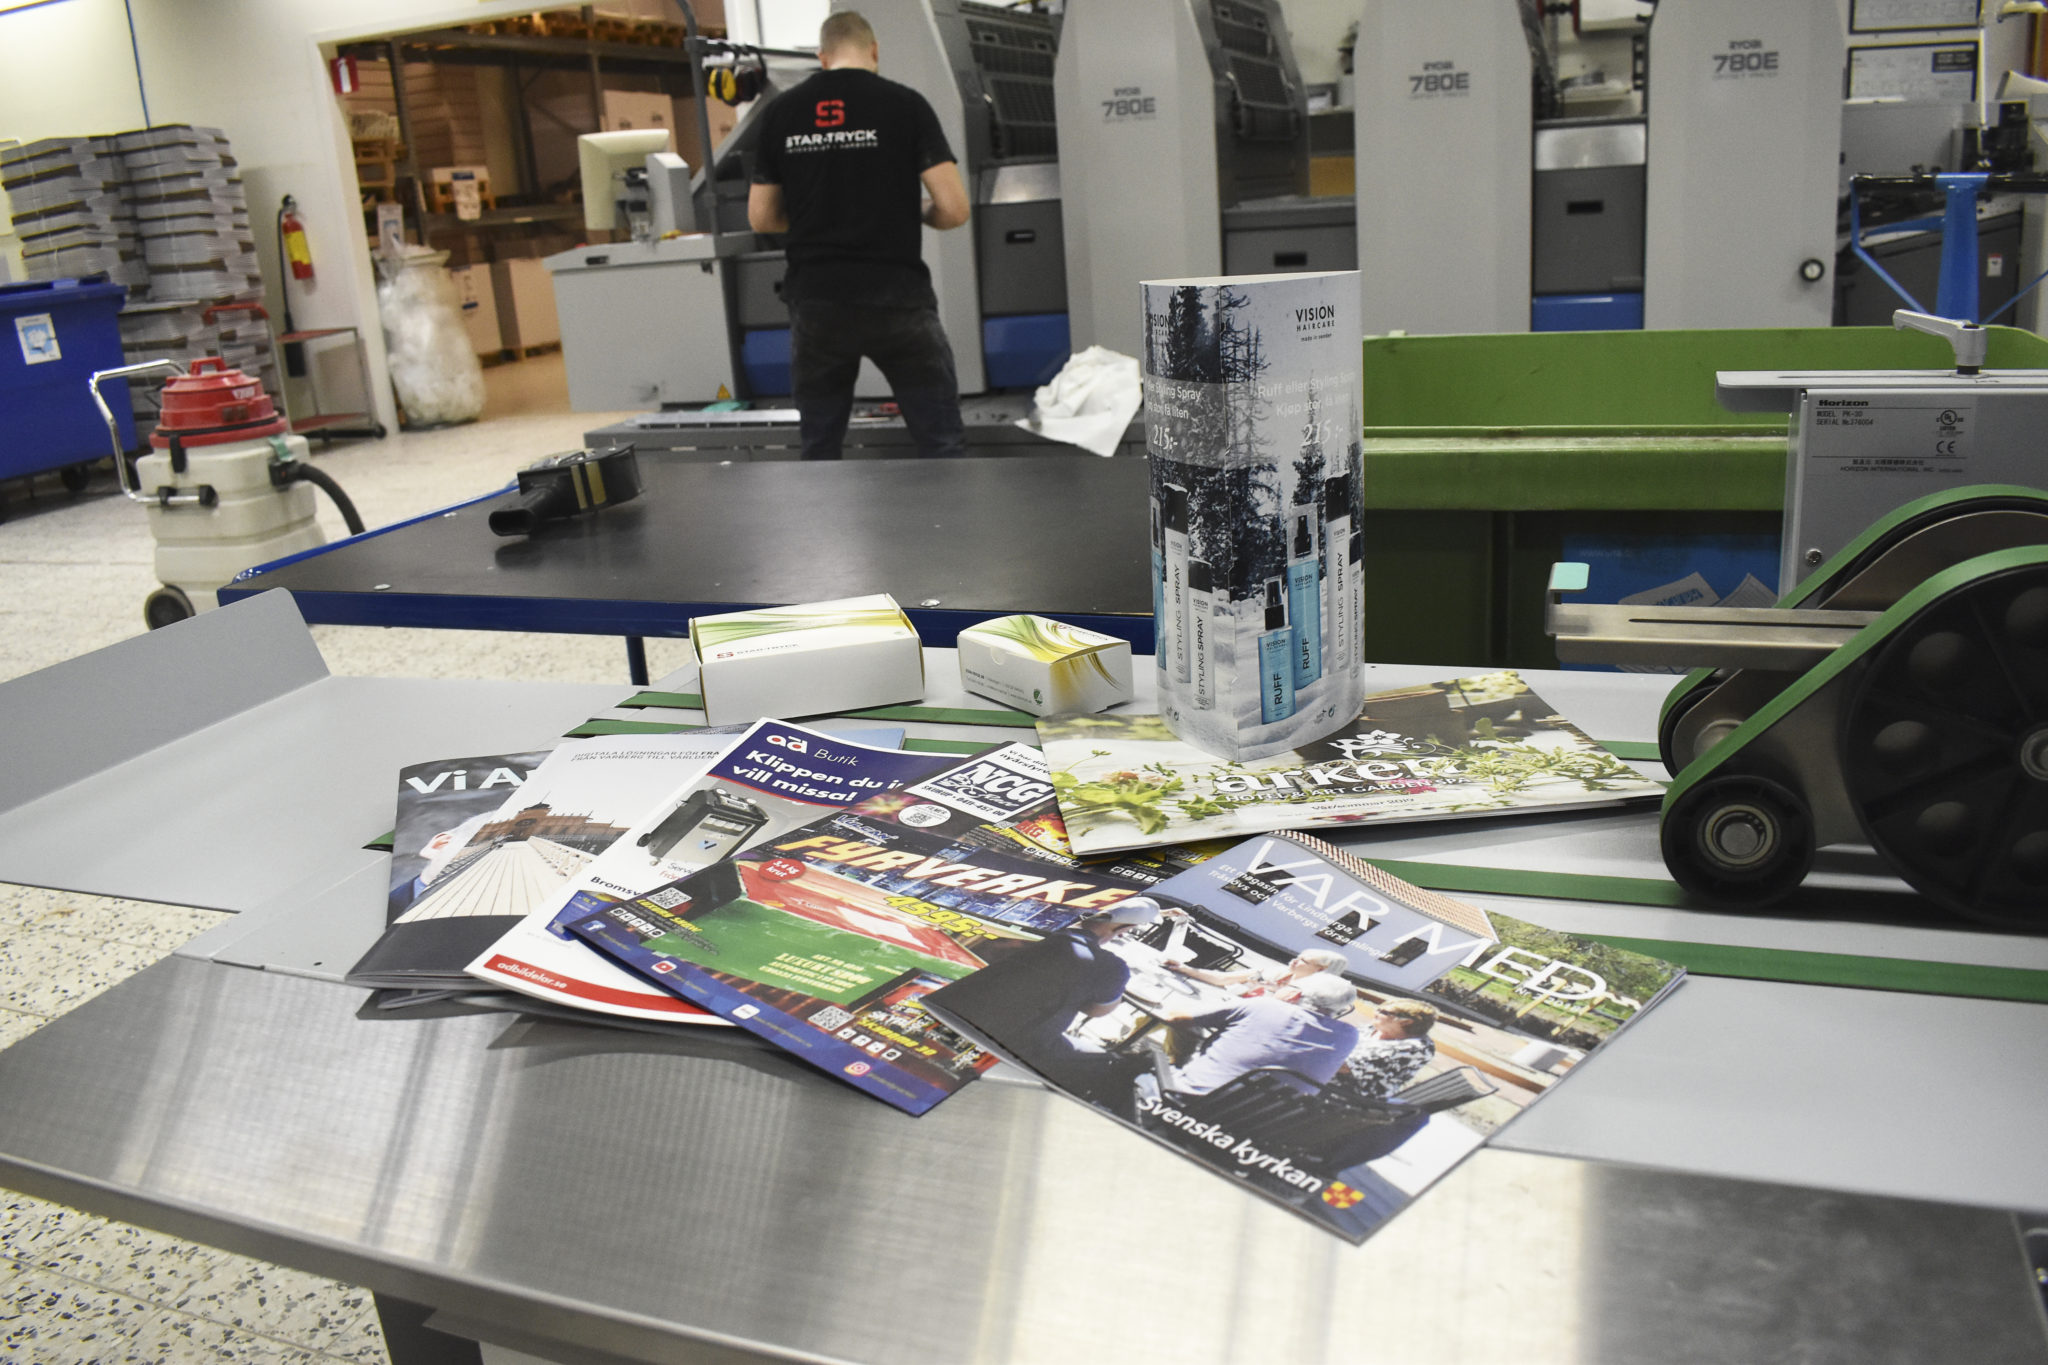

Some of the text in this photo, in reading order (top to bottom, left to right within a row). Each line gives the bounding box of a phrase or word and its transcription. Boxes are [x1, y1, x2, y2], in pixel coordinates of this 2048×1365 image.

[1713, 51, 1779, 73] 780E
[1408, 72, 1470, 94] 780E
[1101, 97, 1156, 117] 780E
[1295, 304, 1335, 322] VISION
[1296, 319, 1335, 332] HAIRCARE
[1177, 385, 1201, 402] Spray
[1257, 382, 1284, 398] Ruff
[1818, 399, 1869, 407] Horizon
[1153, 424, 1178, 450] 215:-
[1173, 563, 1183, 660] STYLING SPRAY
[1337, 596, 1345, 648] STYLING
[1197, 615, 1206, 694] STYLING SPRAY
[1302, 637, 1311, 670] RUFF
[1273, 672, 1283, 706] RUFF
[746, 749, 845, 785] Klippen
[848, 777, 883, 789] du
[814, 748, 859, 767] Butik
[405, 769, 468, 794] Vi
[733, 765, 859, 801] vill missa!
[966, 762, 1054, 803] NCG
[1215, 757, 1463, 793] arken
[1225, 790, 1288, 803] HOTEL
[1310, 786, 1345, 796] ART
[1352, 780, 1432, 793] GARDEN
[1435, 776, 1472, 786] SPA
[1237, 872, 1280, 895] magasin
[1279, 891, 1297, 906] för
[884, 896, 1000, 941] 4595:-
[1250, 889, 1272, 903] och
[1272, 901, 1320, 930] Varbergs
[497, 962, 568, 989] adbildelar.se
[1393, 921, 1608, 1001] MED
[1137, 1095, 1323, 1193] Svenska kyrkan
